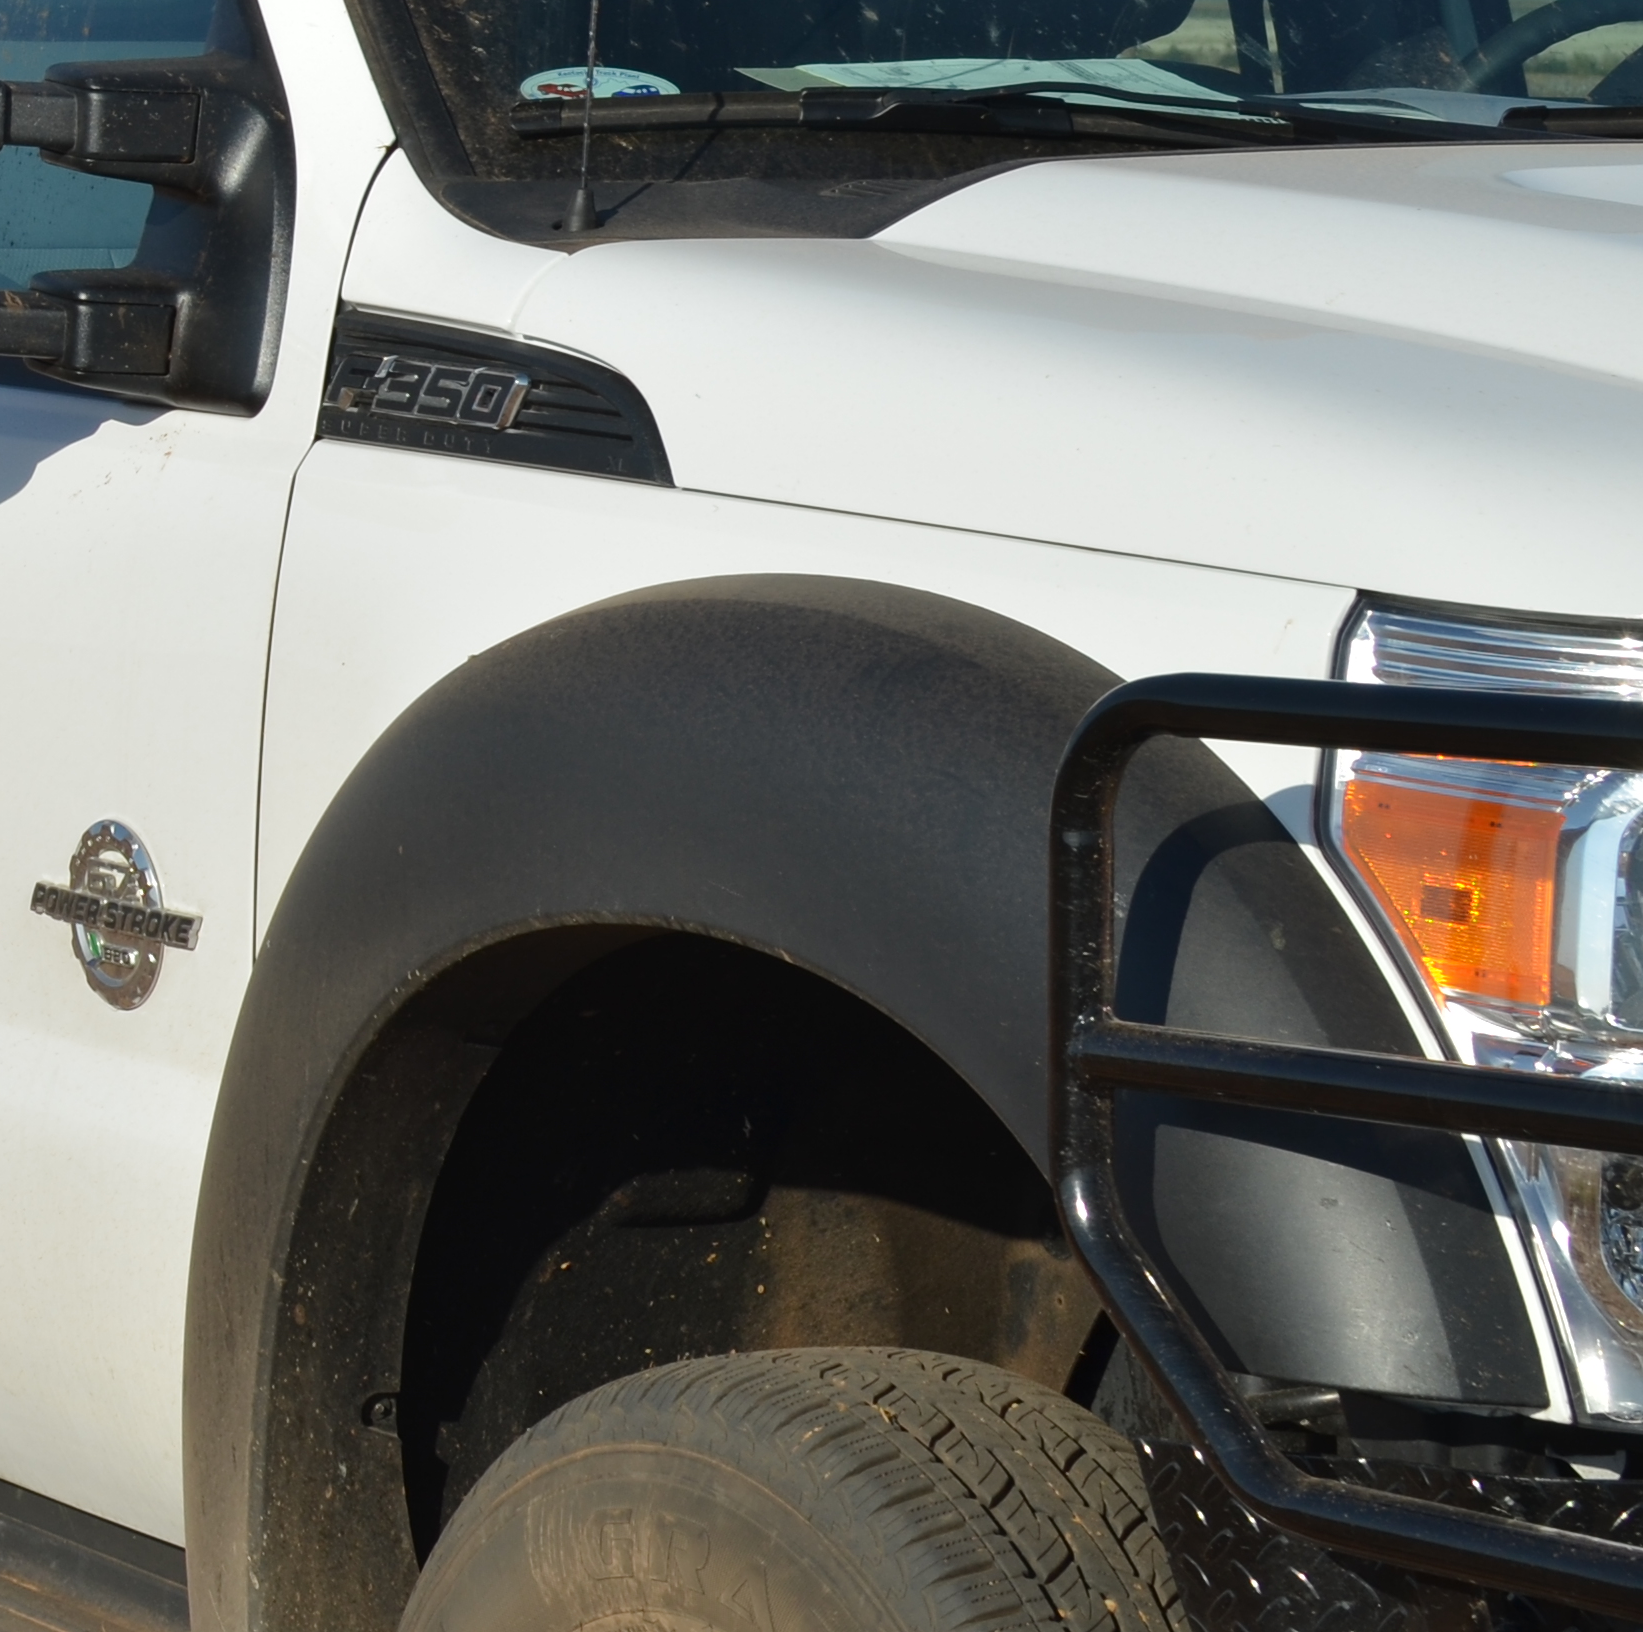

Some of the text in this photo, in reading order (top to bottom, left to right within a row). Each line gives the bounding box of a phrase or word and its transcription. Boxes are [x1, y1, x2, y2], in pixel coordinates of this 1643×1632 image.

[321, 419, 493, 454] SUPER DUTY
[32, 881, 196, 945] POWER STROKE
